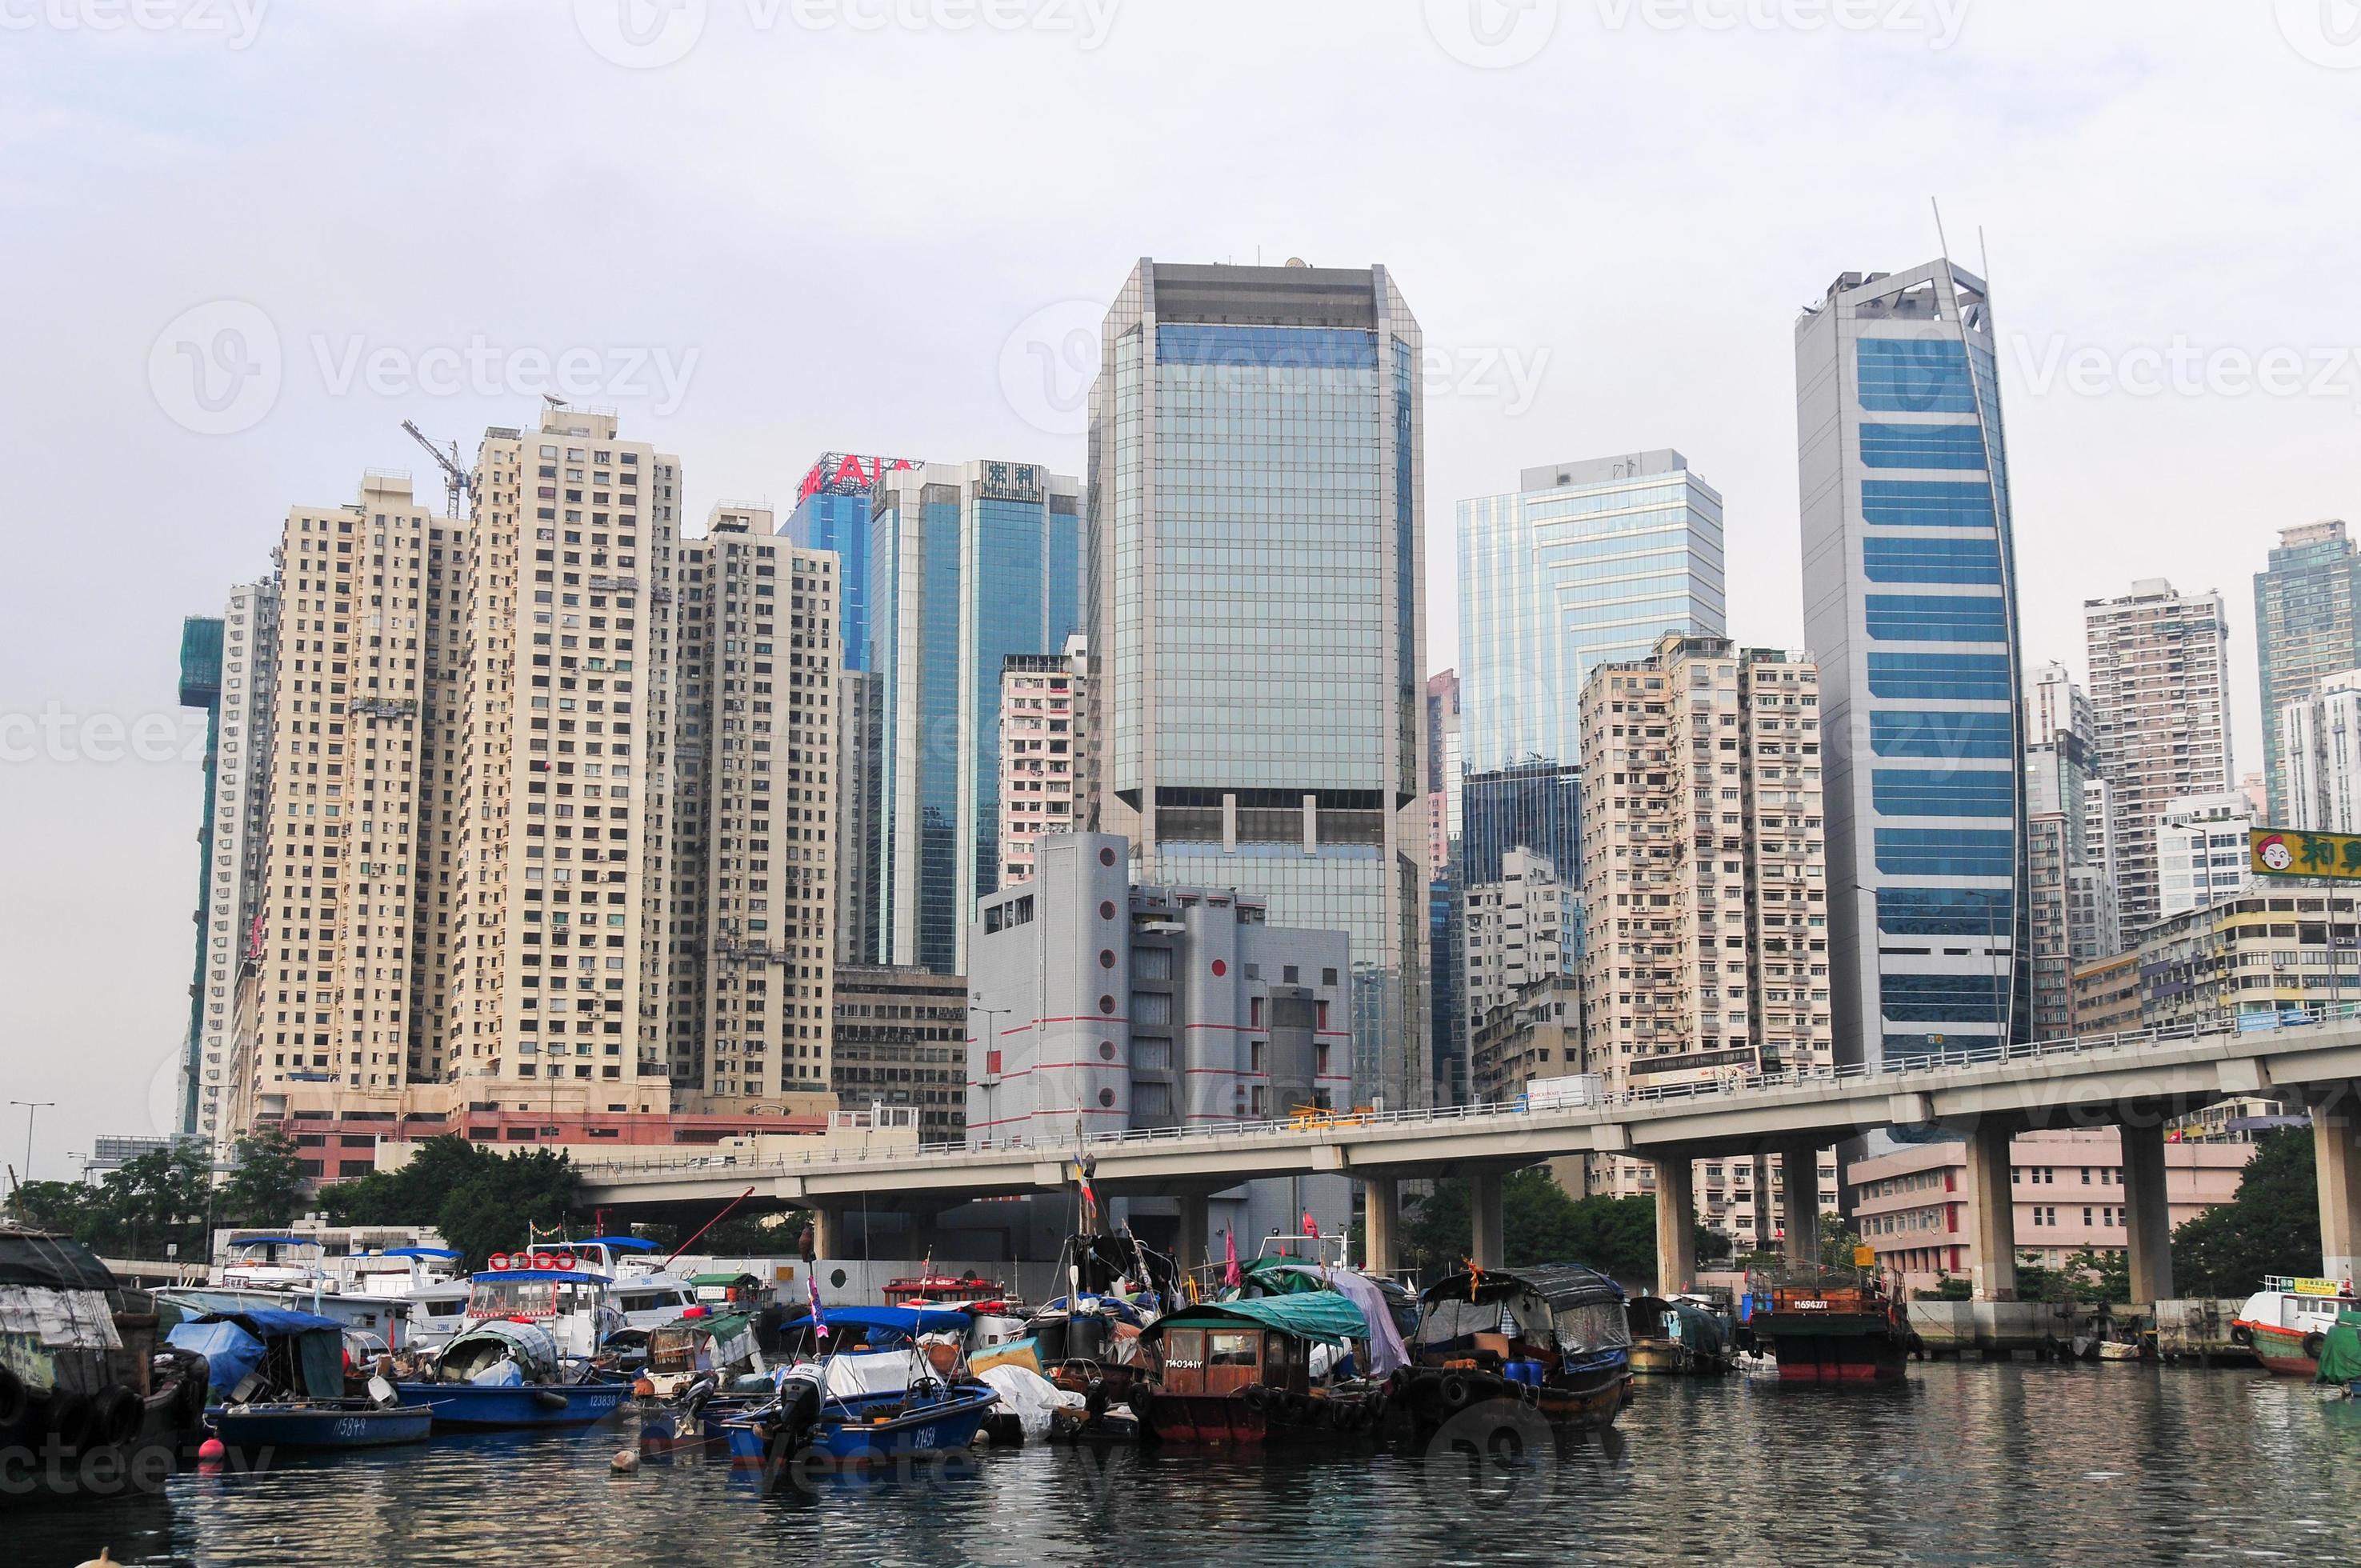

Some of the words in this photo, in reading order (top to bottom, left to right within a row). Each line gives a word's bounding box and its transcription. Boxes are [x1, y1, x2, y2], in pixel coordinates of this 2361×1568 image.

[590, 1394, 616, 1406] 123838
[333, 1417, 366, 1437] 115848
[914, 1426, 936, 1449] 81458
